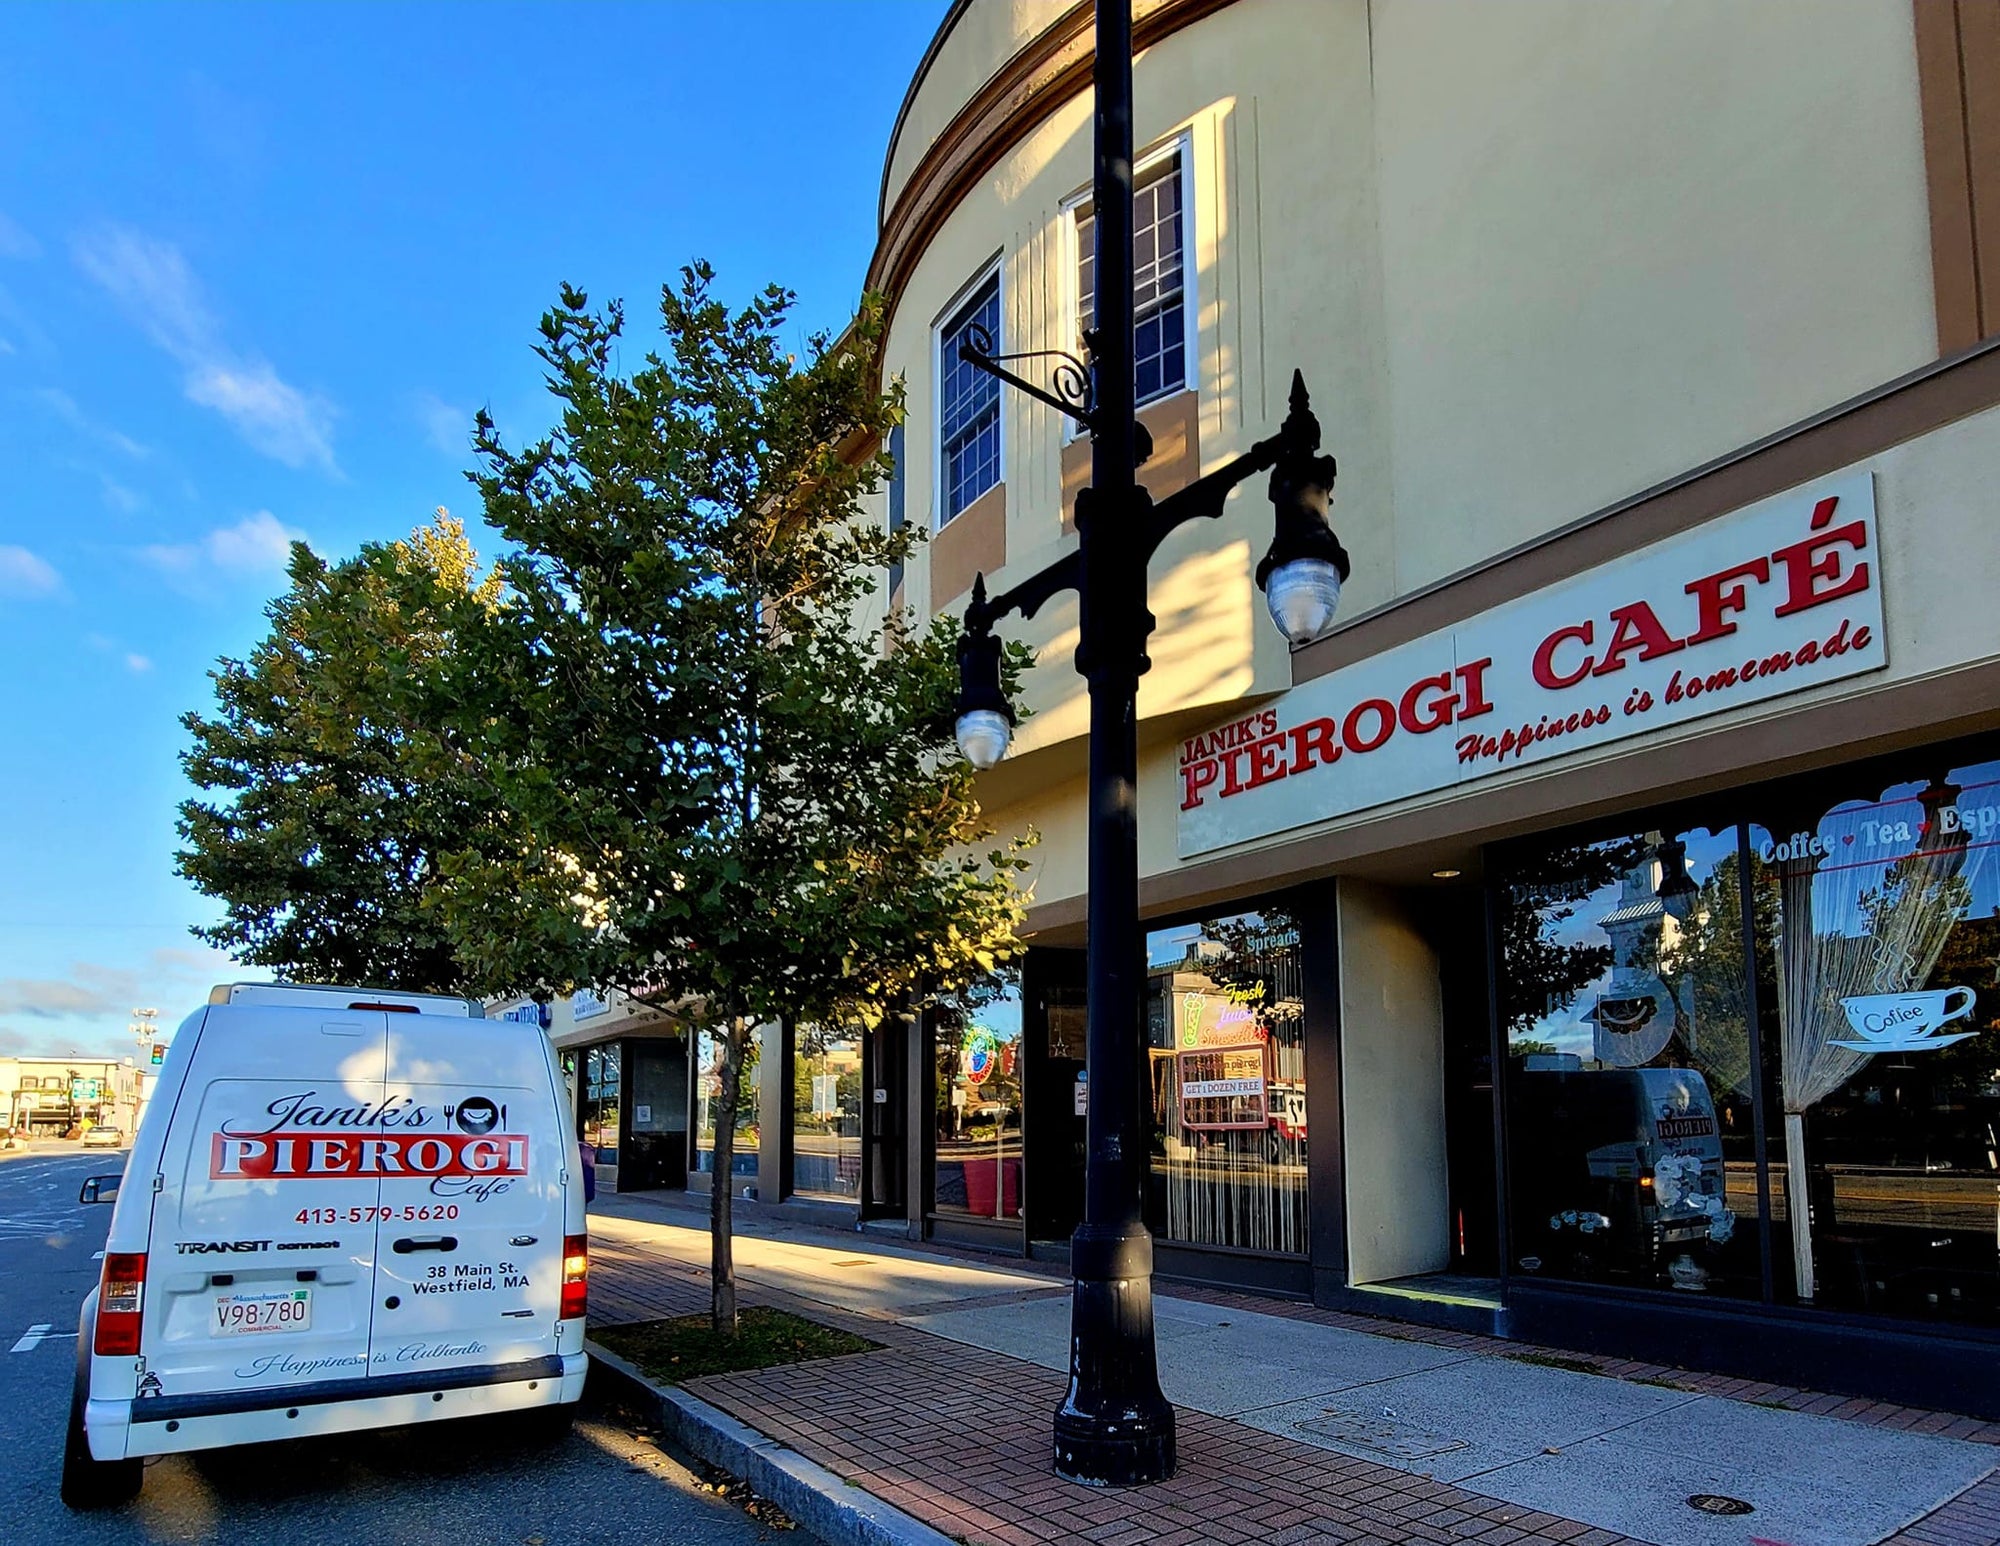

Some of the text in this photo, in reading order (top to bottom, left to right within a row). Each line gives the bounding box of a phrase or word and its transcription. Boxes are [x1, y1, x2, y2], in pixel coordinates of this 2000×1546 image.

[1180, 496, 1870, 812] PIEROGI CAFÉ
[1455, 619, 1873, 765] Happiness is homemade
[1180, 708, 1278, 765] JANIK'S
[1759, 805, 2000, 864] Coffee Tea Esp
[1245, 928, 1301, 954] Spreads
[1223, 979, 1267, 1002] Fresh
[1863, 1006, 1924, 1034] Coffee
[1186, 1084, 1202, 1095] GET
[1208, 1083, 1236, 1093] DOZEN
[1238, 1081, 1259, 1092] FREE
[221, 1091, 433, 1138] Janik's
[219, 1138, 526, 1174] PIEROGI
[294, 1204, 459, 1225] 413-579-5620
[174, 1240, 273, 1255] TRANSIT
[427, 1262, 519, 1279] 38 Main St.
[412, 1275, 530, 1295] Westfield, MA
[234, 1340, 488, 1379] Happiness is Authentic
